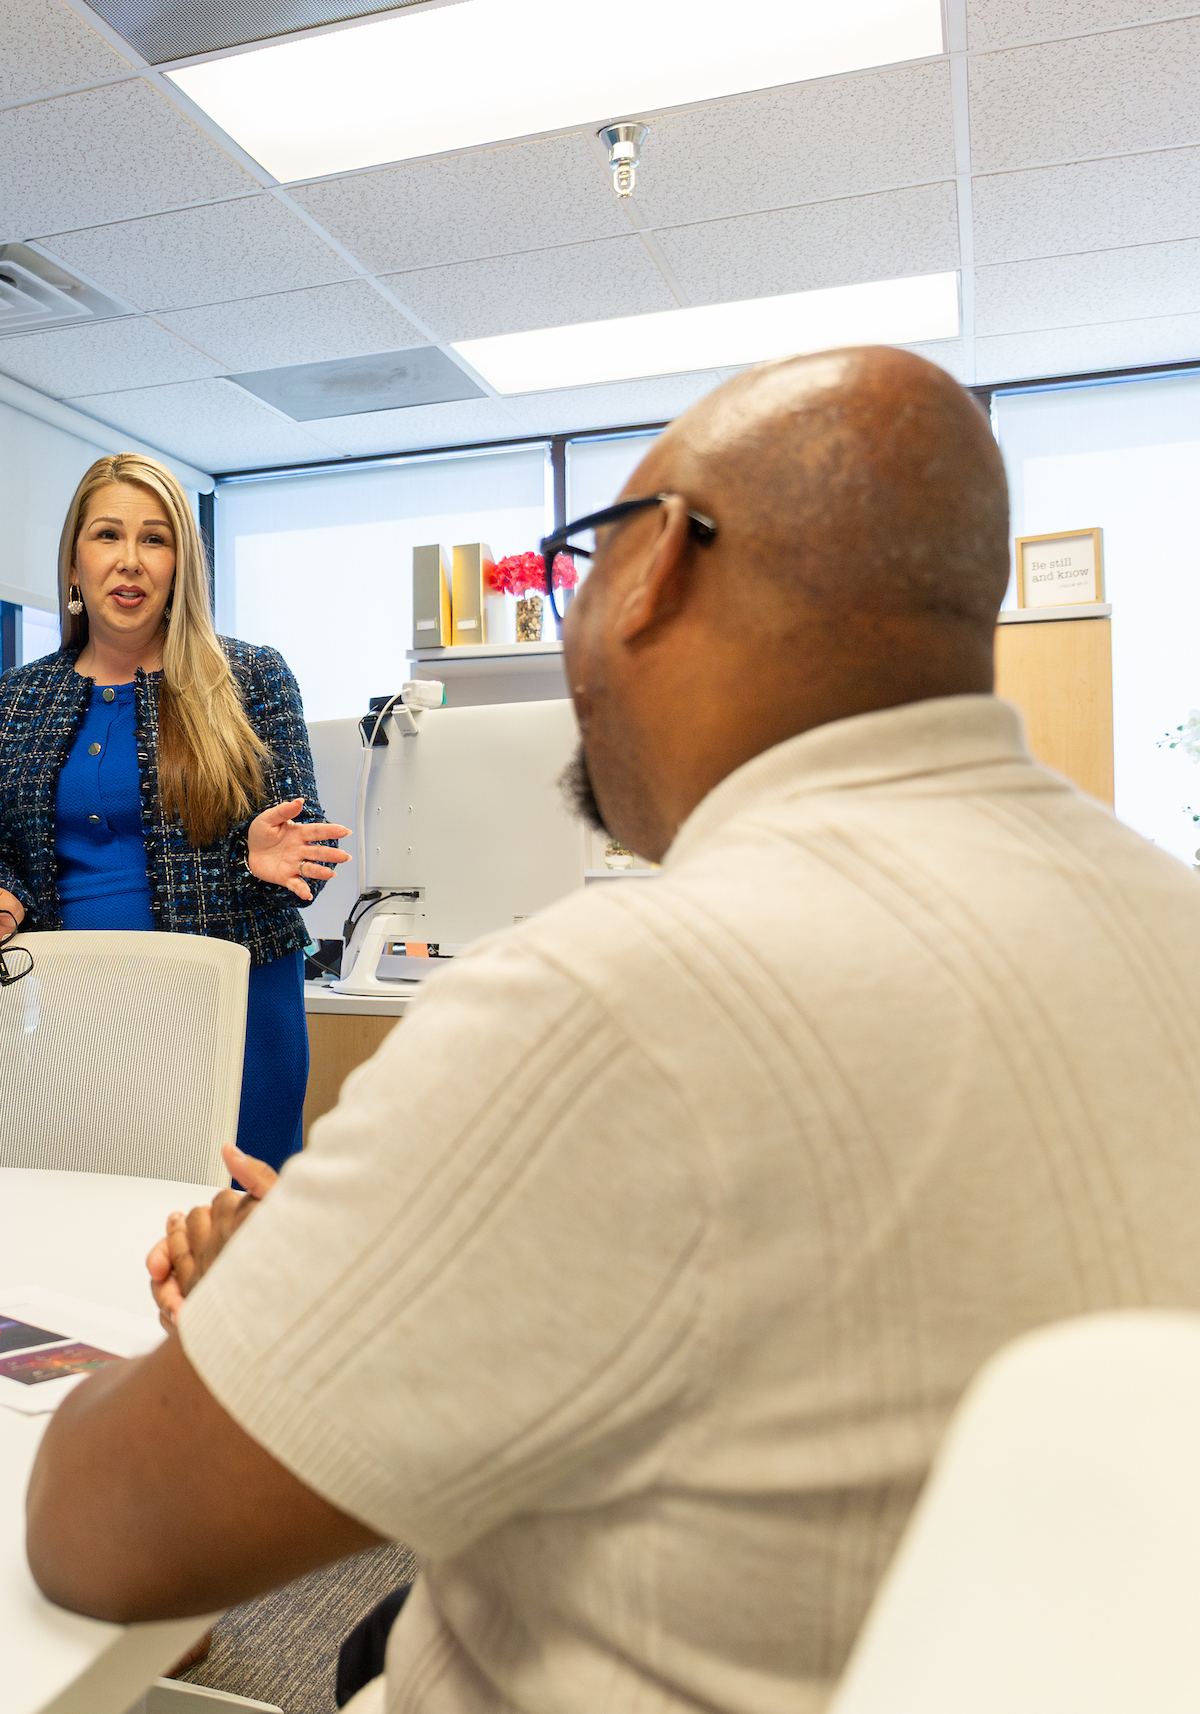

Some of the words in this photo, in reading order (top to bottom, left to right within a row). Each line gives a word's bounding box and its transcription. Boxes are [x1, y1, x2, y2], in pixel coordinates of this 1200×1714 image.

[1032, 561, 1046, 571] Be
[1049, 557, 1072, 569] still
[1032, 572, 1054, 583] and
[1057, 568, 1089, 580] know
